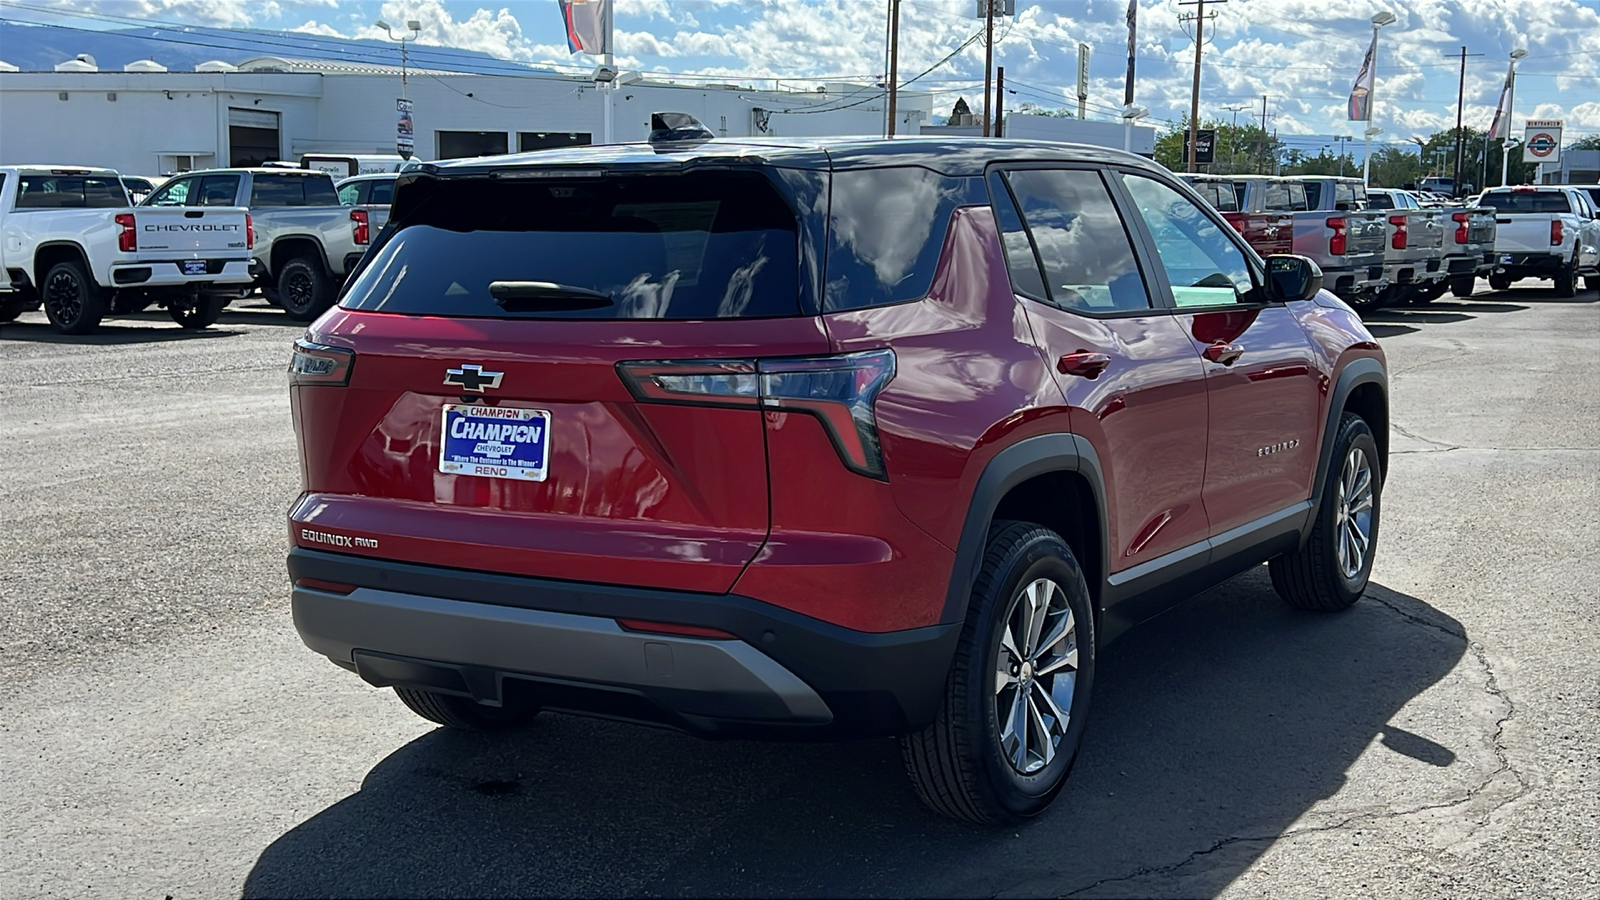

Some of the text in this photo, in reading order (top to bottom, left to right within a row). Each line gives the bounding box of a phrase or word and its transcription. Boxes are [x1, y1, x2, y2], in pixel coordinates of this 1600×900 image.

[144, 224, 240, 232] CHEVROLET
[470, 407, 520, 419] CHAMPION
[451, 417, 541, 443] CHAMPION
[476, 444, 512, 453] CHEVROLET
[1257, 439, 1300, 457] EQUINOX
[475, 466, 508, 476] RENO
[301, 528, 379, 549] EQUINOX AWD
